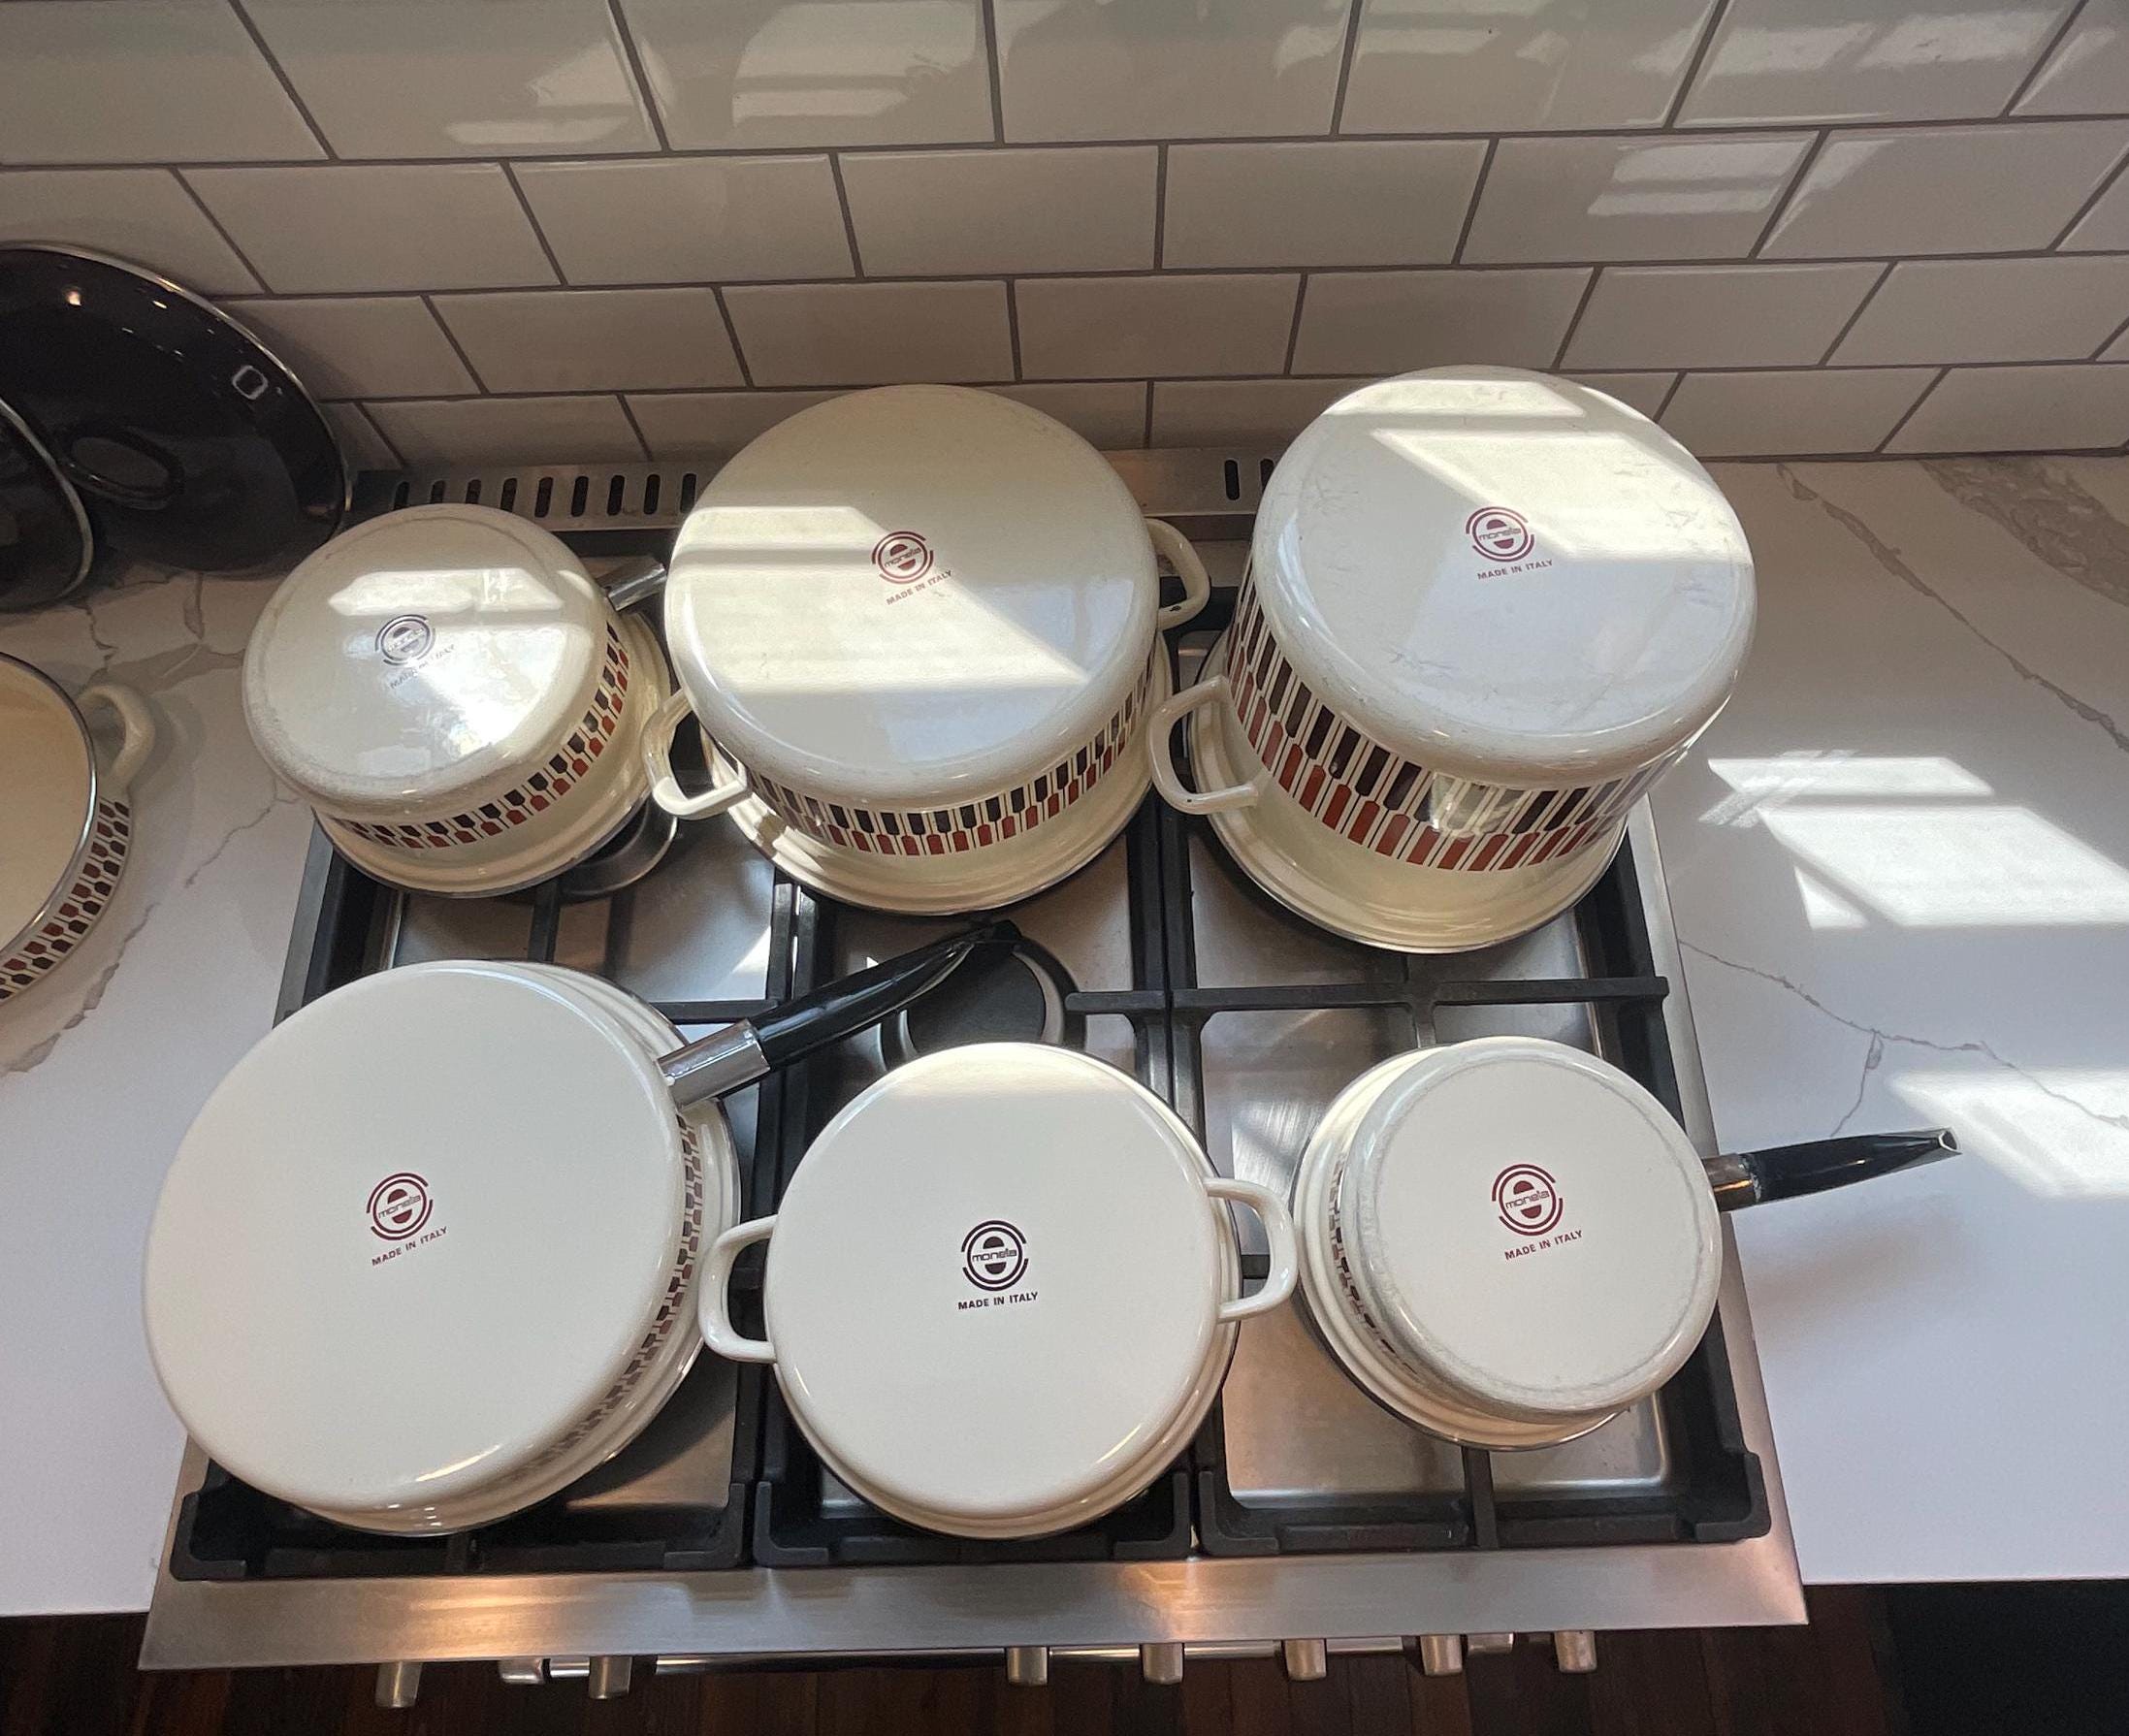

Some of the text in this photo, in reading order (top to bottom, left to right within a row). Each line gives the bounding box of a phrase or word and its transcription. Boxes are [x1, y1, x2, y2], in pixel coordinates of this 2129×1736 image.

[1477, 560, 1553, 580] MADE IN ITALY
[886, 570, 952, 605] MADE IN ITALY
[371, 1226, 447, 1267] MADE IN ITALY
[1504, 1230, 1583, 1261] MADE IN ITALY
[957, 1292, 1039, 1310] MADE IN ITALY
